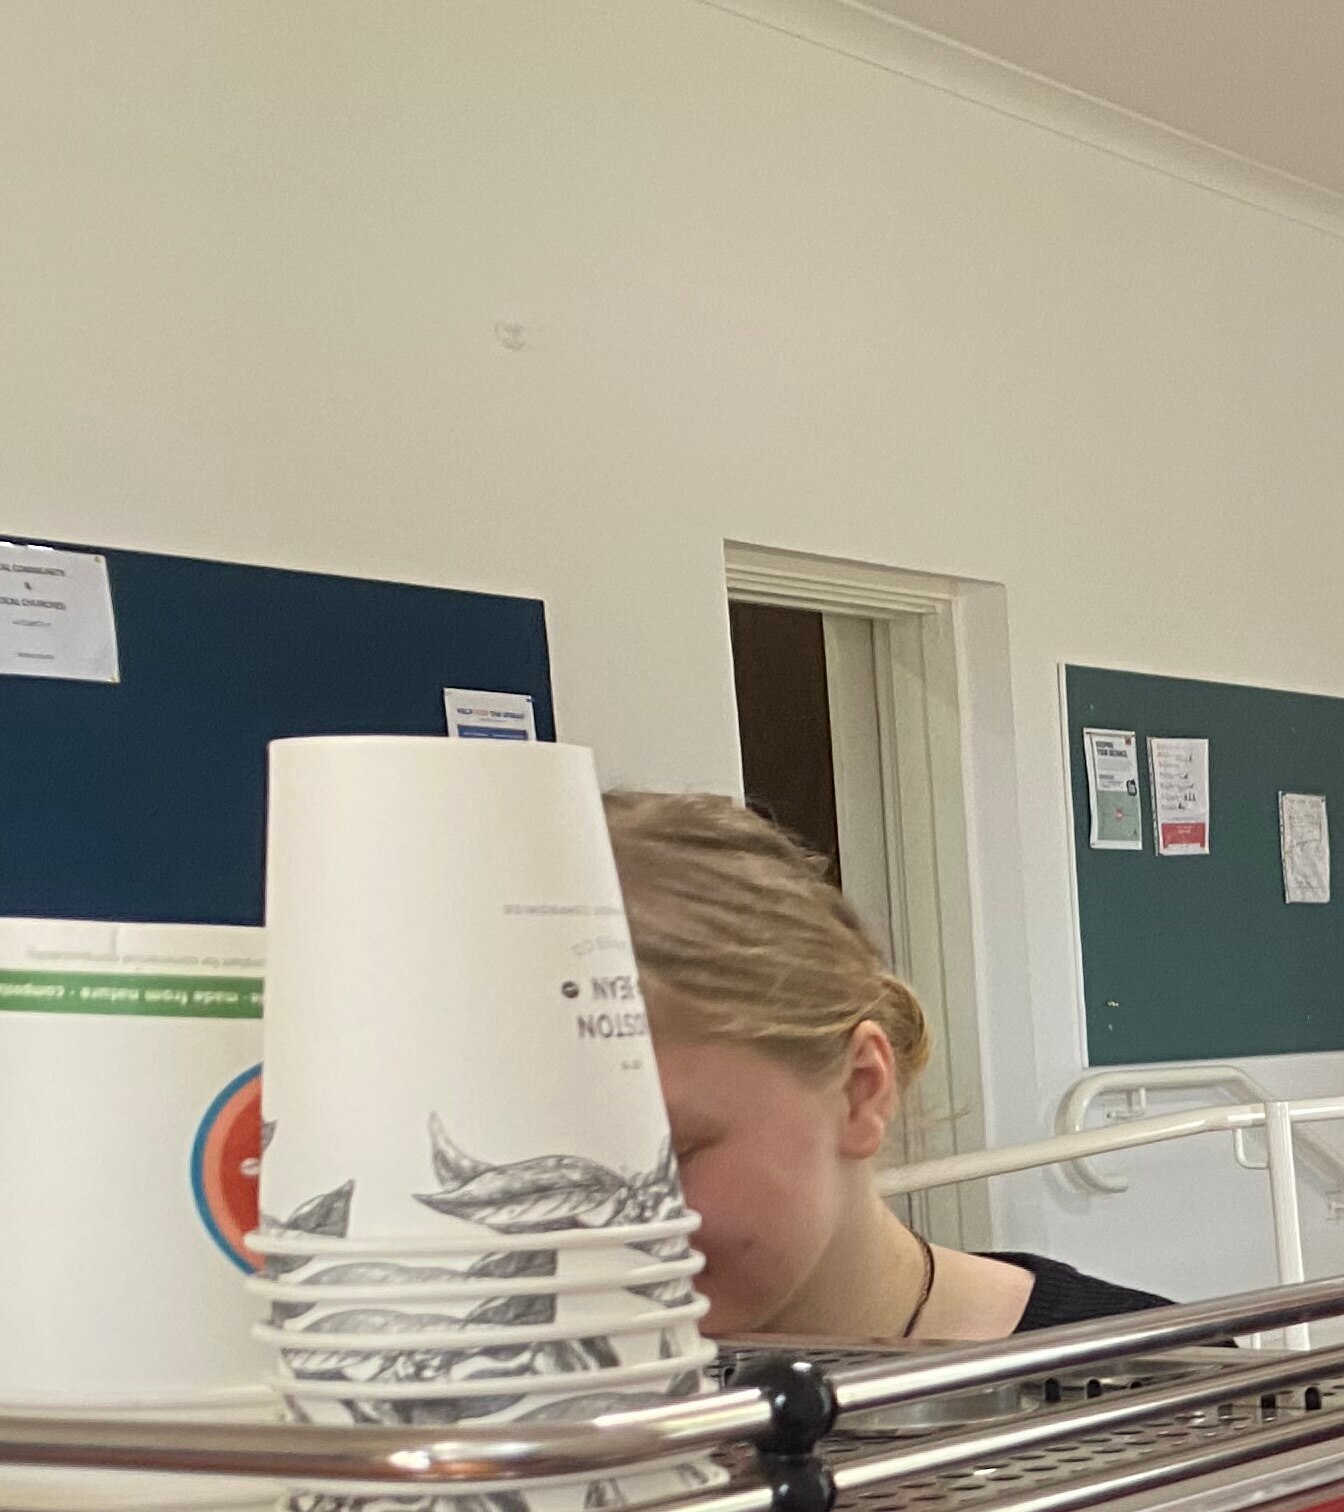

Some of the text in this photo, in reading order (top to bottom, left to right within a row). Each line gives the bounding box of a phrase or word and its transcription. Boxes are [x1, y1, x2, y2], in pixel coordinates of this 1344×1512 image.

[80, 986, 139, 1003] nature
[145, 989, 189, 1007] from
[193, 990, 239, 1006] made
